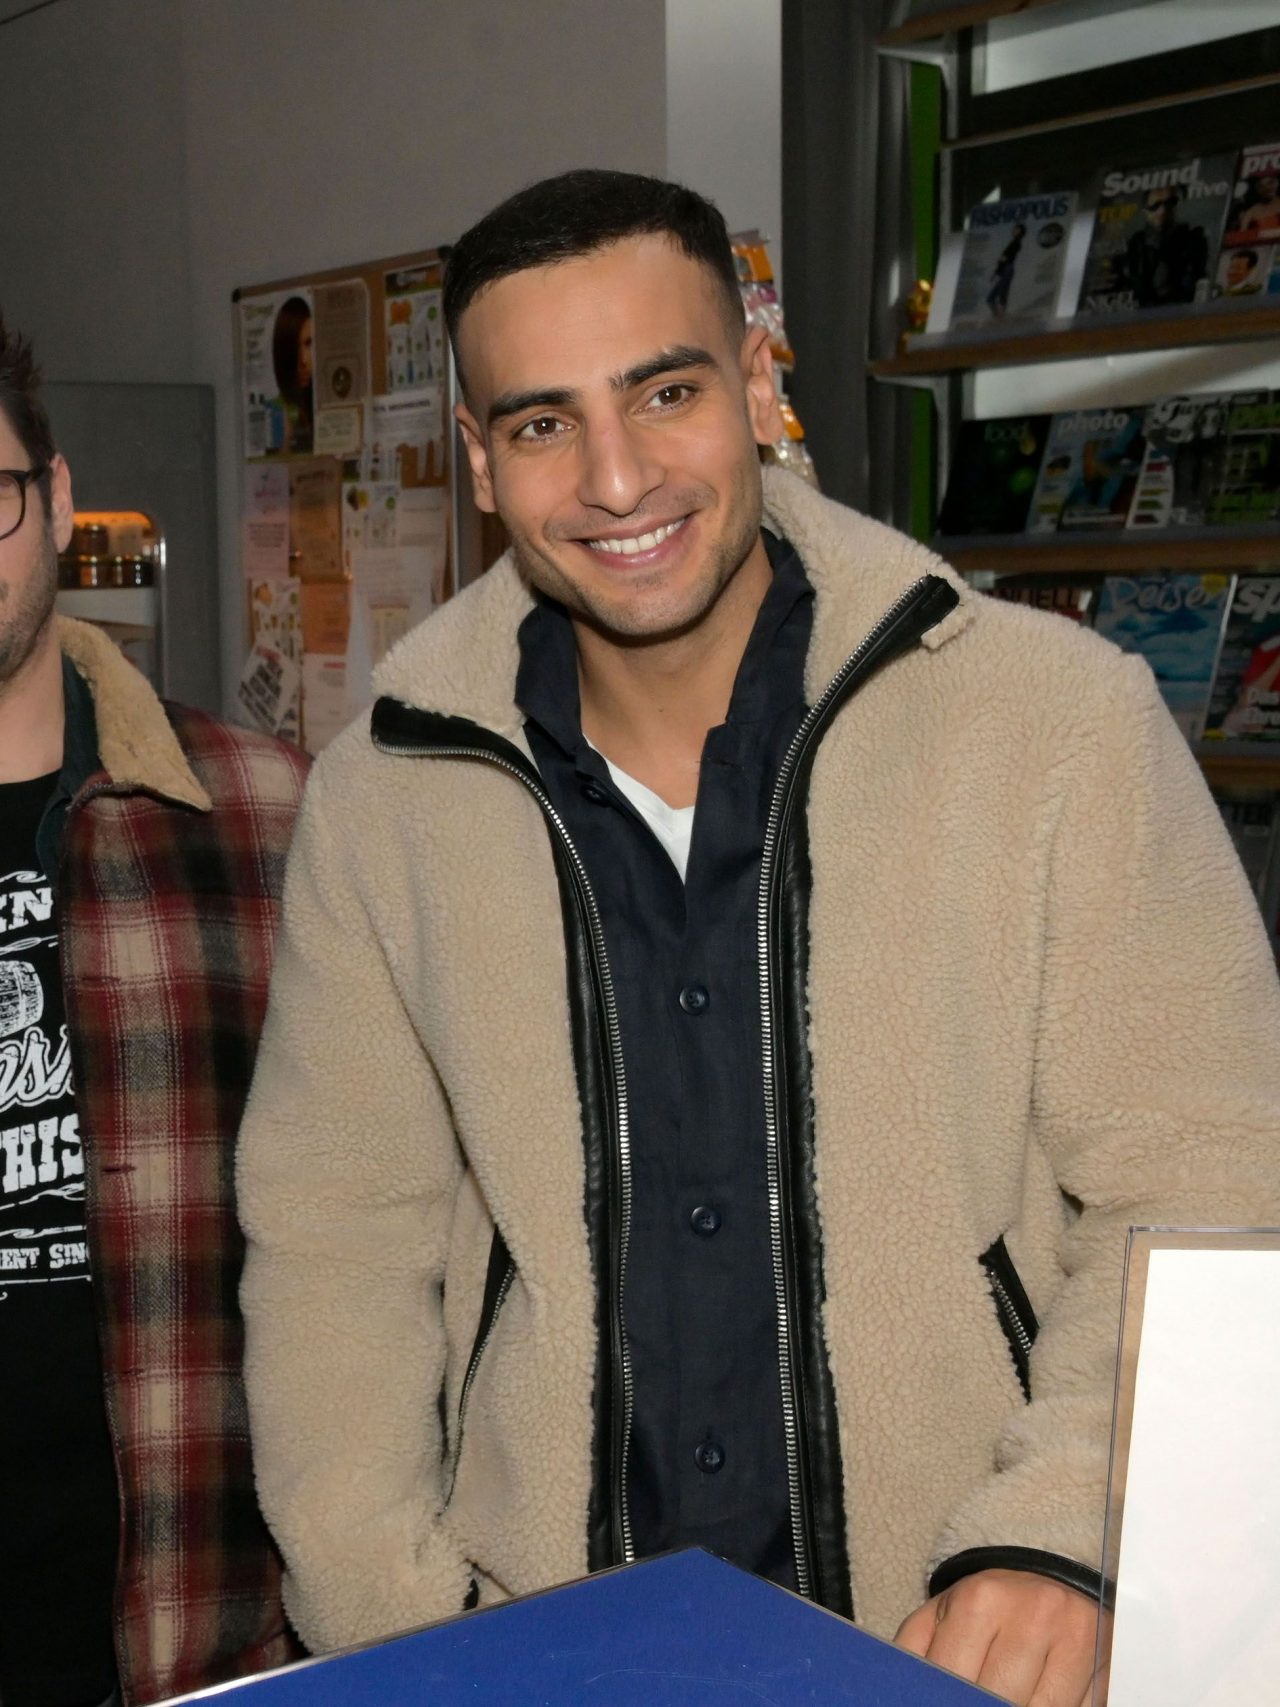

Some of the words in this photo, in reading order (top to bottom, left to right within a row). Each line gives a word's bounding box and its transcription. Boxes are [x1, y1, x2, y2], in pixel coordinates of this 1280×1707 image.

[1101, 158, 1201, 198] Sound
[1056, 409, 1130, 439] photo
[48, 1242, 91, 1269] SIN
